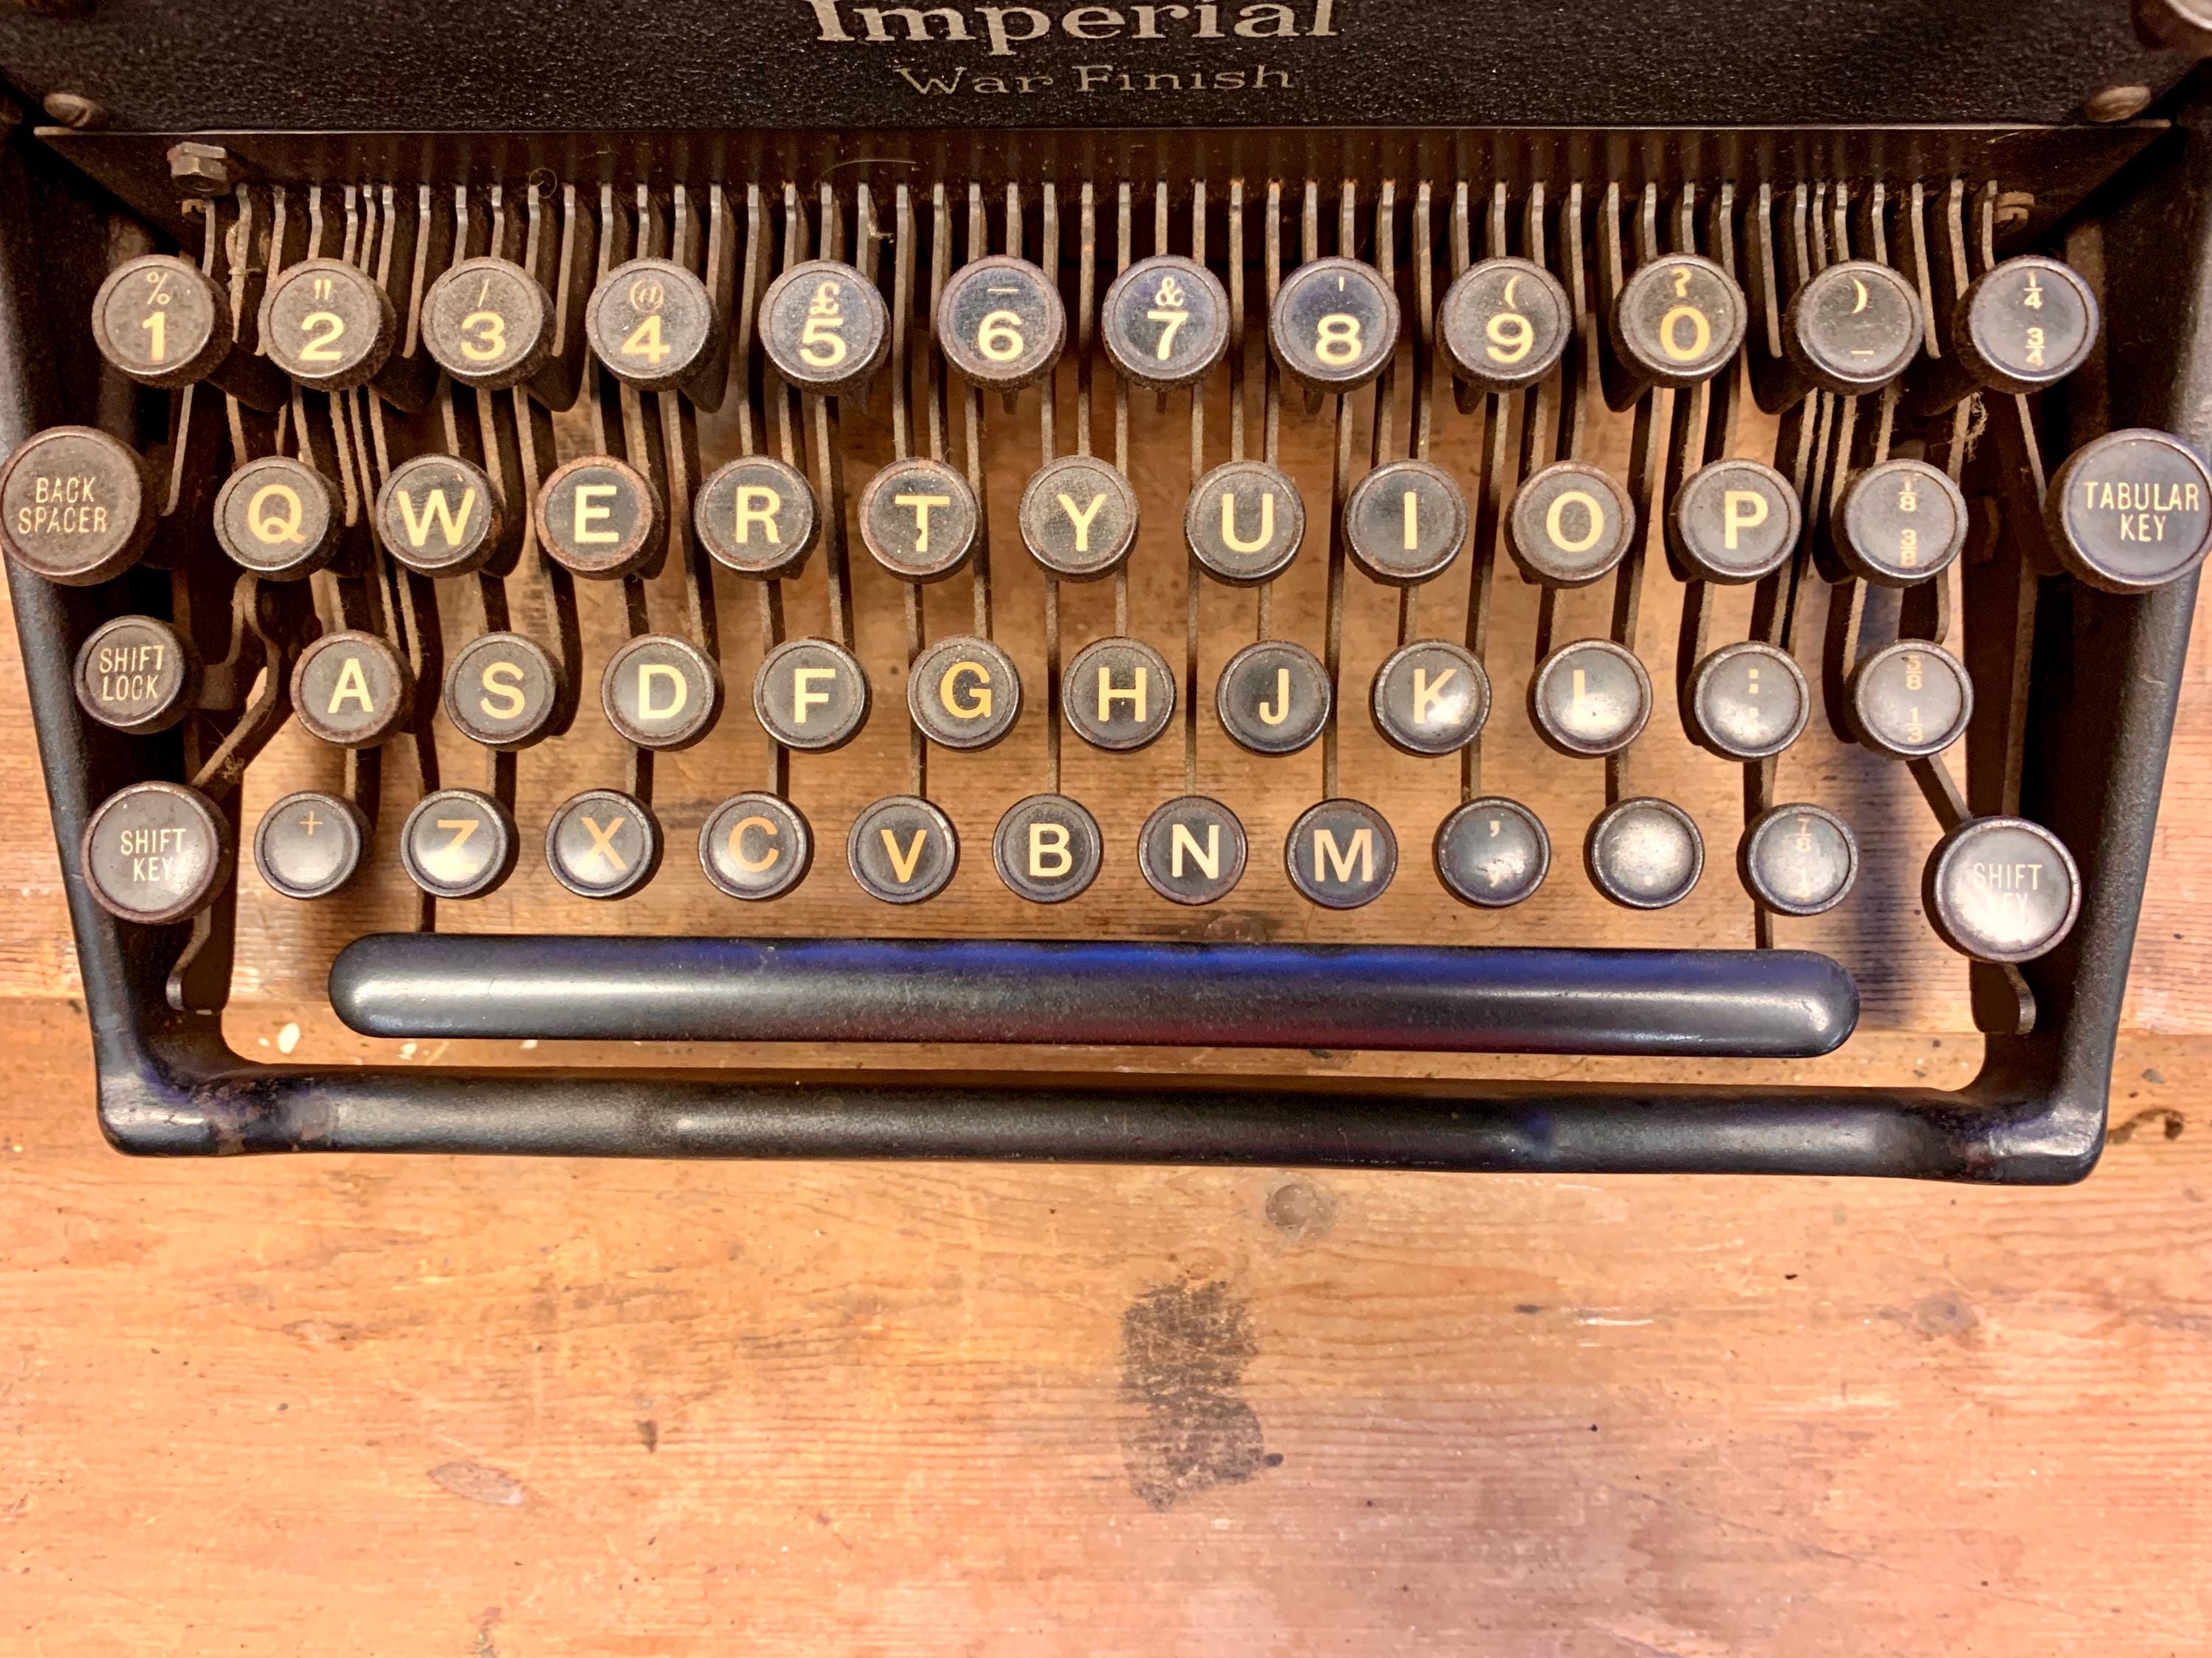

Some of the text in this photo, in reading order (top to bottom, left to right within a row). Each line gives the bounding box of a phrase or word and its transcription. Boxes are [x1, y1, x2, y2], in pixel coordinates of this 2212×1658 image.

[814, 0, 1338, 56] Imperial
[893, 64, 1294, 94] War Finish
[810, 282, 840, 316] £
[1155, 276, 1184, 307] &
[1669, 266, 1691, 297] ?
[142, 312, 164, 360] 1
[299, 313, 344, 360] 2
[461, 312, 506, 360] 3
[622, 316, 671, 363] 4
[800, 318, 846, 366] 5
[978, 310, 1023, 361] 6
[1147, 311, 1189, 360] 7
[1315, 315, 1362, 365] 8
[1486, 313, 1533, 363] 9
[34, 476, 96, 504] BACK
[248, 484, 305, 543] Q
[397, 487, 476, 546] W
[574, 485, 619, 543] E
[736, 487, 781, 543] R
[2083, 481, 2200, 512] TABULAR
[18, 508, 108, 534] SPACER
[895, 495, 950, 552] T
[1057, 494, 1107, 551] Y
[1222, 493, 1273, 552] U
[1405, 492, 1417, 549] I
[1547, 492, 1604, 552] O
[1725, 491, 1767, 549] P
[2121, 514, 2166, 542] KEY
[98, 645, 164, 672] SHIFT
[102, 673, 158, 701] LOCK
[328, 658, 373, 713] A
[481, 662, 525, 719] S
[638, 665, 686, 723] D
[795, 669, 835, 723] F
[941, 662, 991, 718] G
[1099, 667, 1147, 722] H
[1259, 669, 1289, 725] J
[1412, 667, 1461, 724] K
[1573, 669, 1616, 725] L
[121, 828, 187, 854] SHIFT
[299, 810, 323, 835] +
[437, 818, 481, 873] Z
[581, 818, 627, 870] X
[727, 816, 779, 873] C
[133, 857, 174, 882] KEY
[881, 829, 927, 882] V
[1029, 823, 1071, 877] B
[1172, 824, 1220, 879] N
[1314, 829, 1375, 882] M
[1973, 863, 2042, 890] SHIFT
